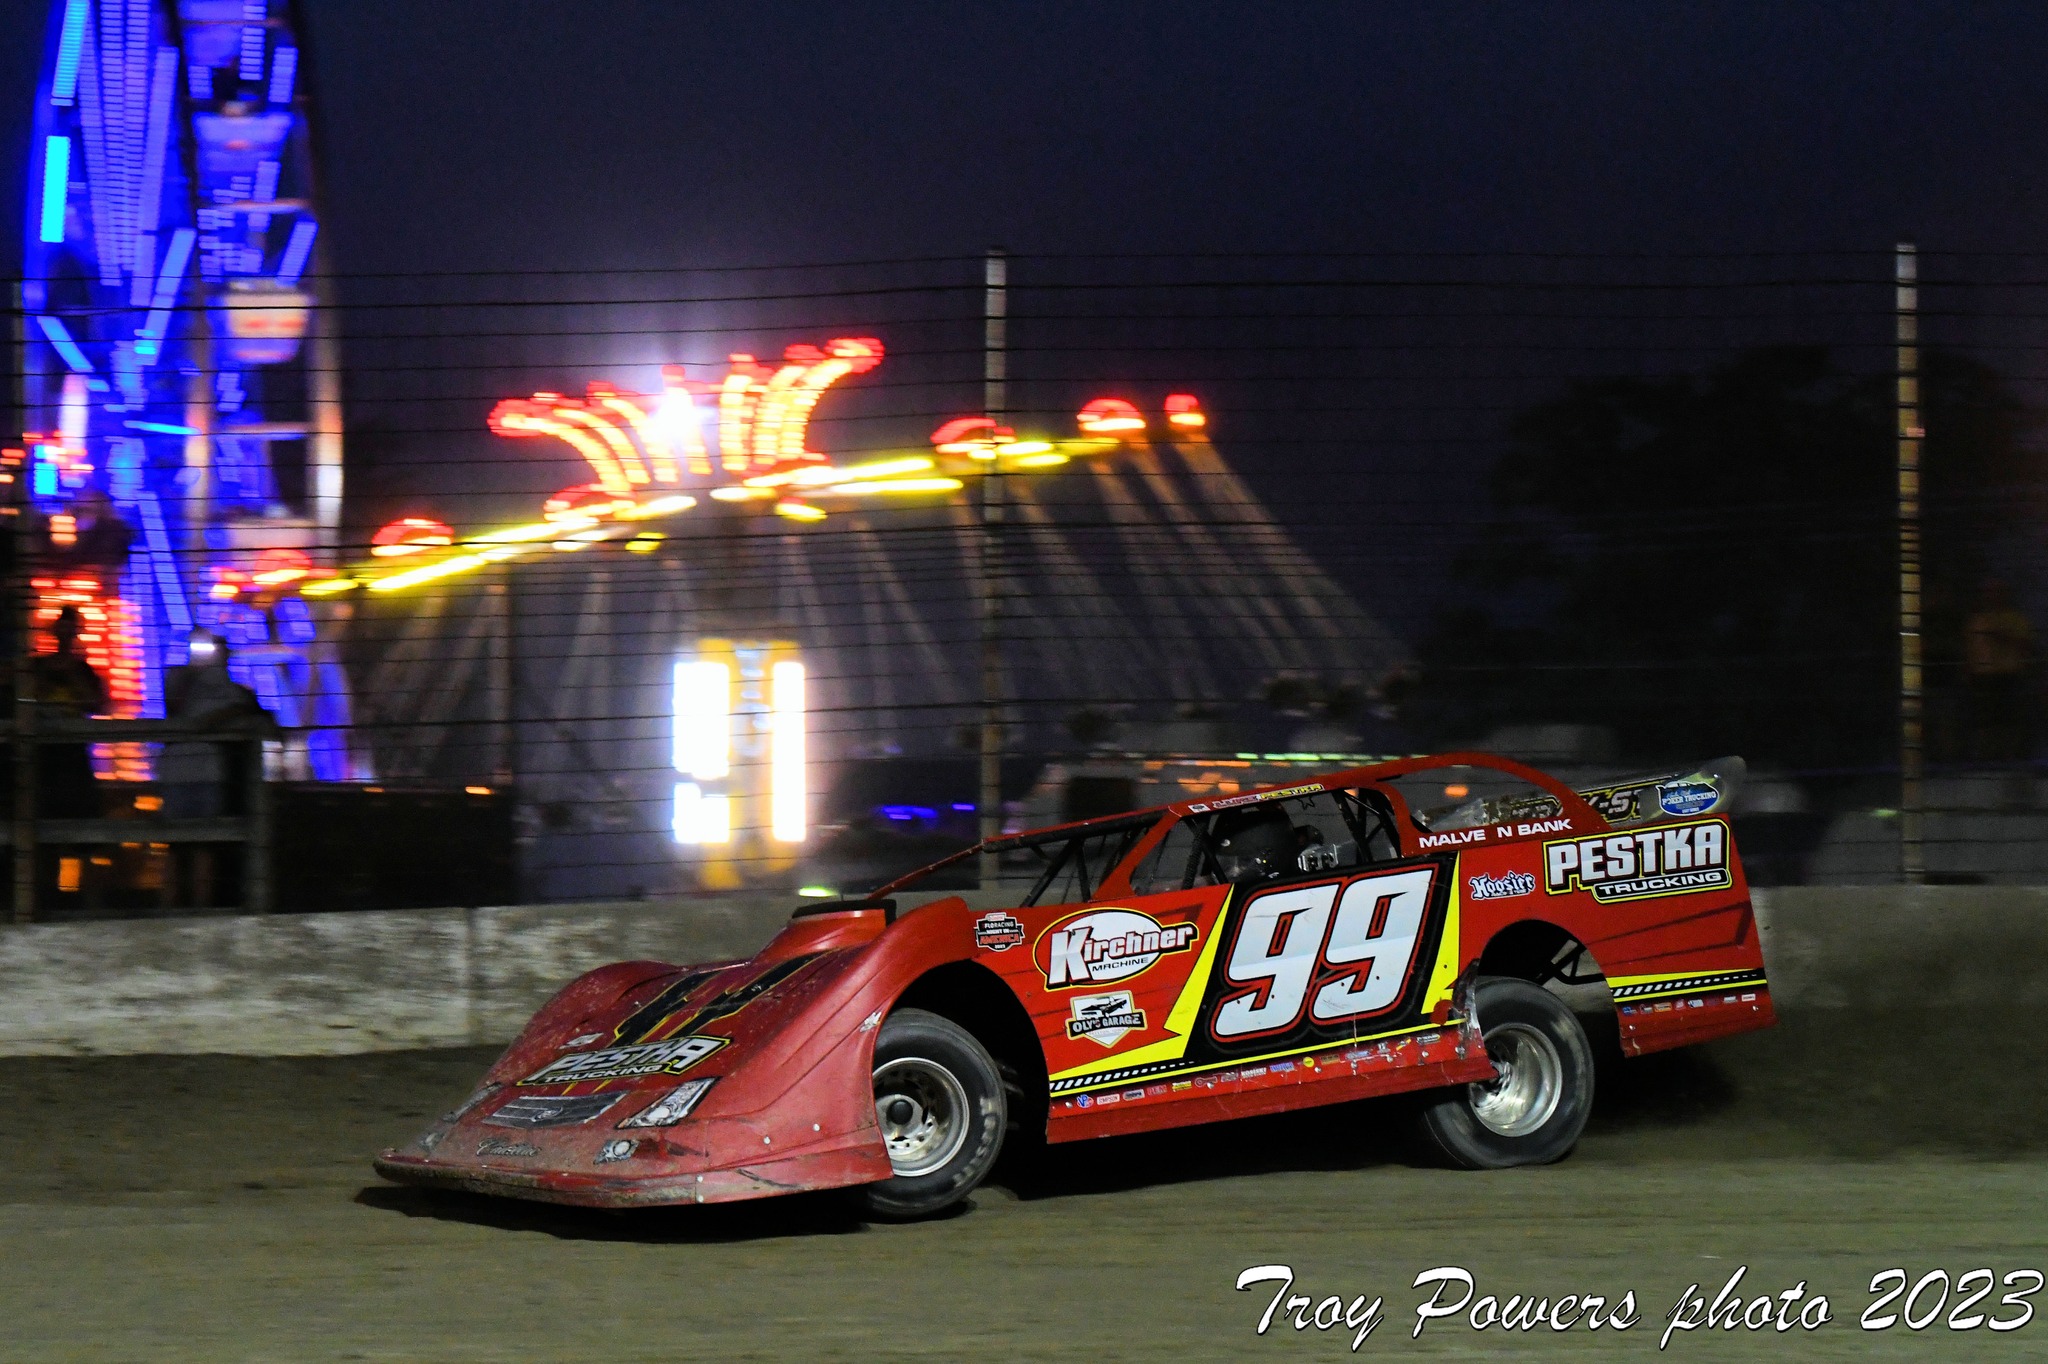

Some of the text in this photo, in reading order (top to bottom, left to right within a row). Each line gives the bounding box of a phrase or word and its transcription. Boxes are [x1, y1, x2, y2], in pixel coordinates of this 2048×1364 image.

[1517, 818, 1574, 837] BANK
[1548, 824, 1723, 886] PESTKA
[1470, 871, 1534, 899] Hoosier
[1600, 872, 1723, 896] TRUCKING
[1048, 926, 1194, 985] Kirchner
[1091, 956, 1149, 972] MACHINE
[1214, 868, 1434, 1037] 99
[1072, 1018, 1102, 1033] OLY'S
[1102, 1013, 1142, 1027] GARAGE
[527, 1037, 725, 1082] PESTKA
[545, 1064, 663, 1083] TRUCKING
